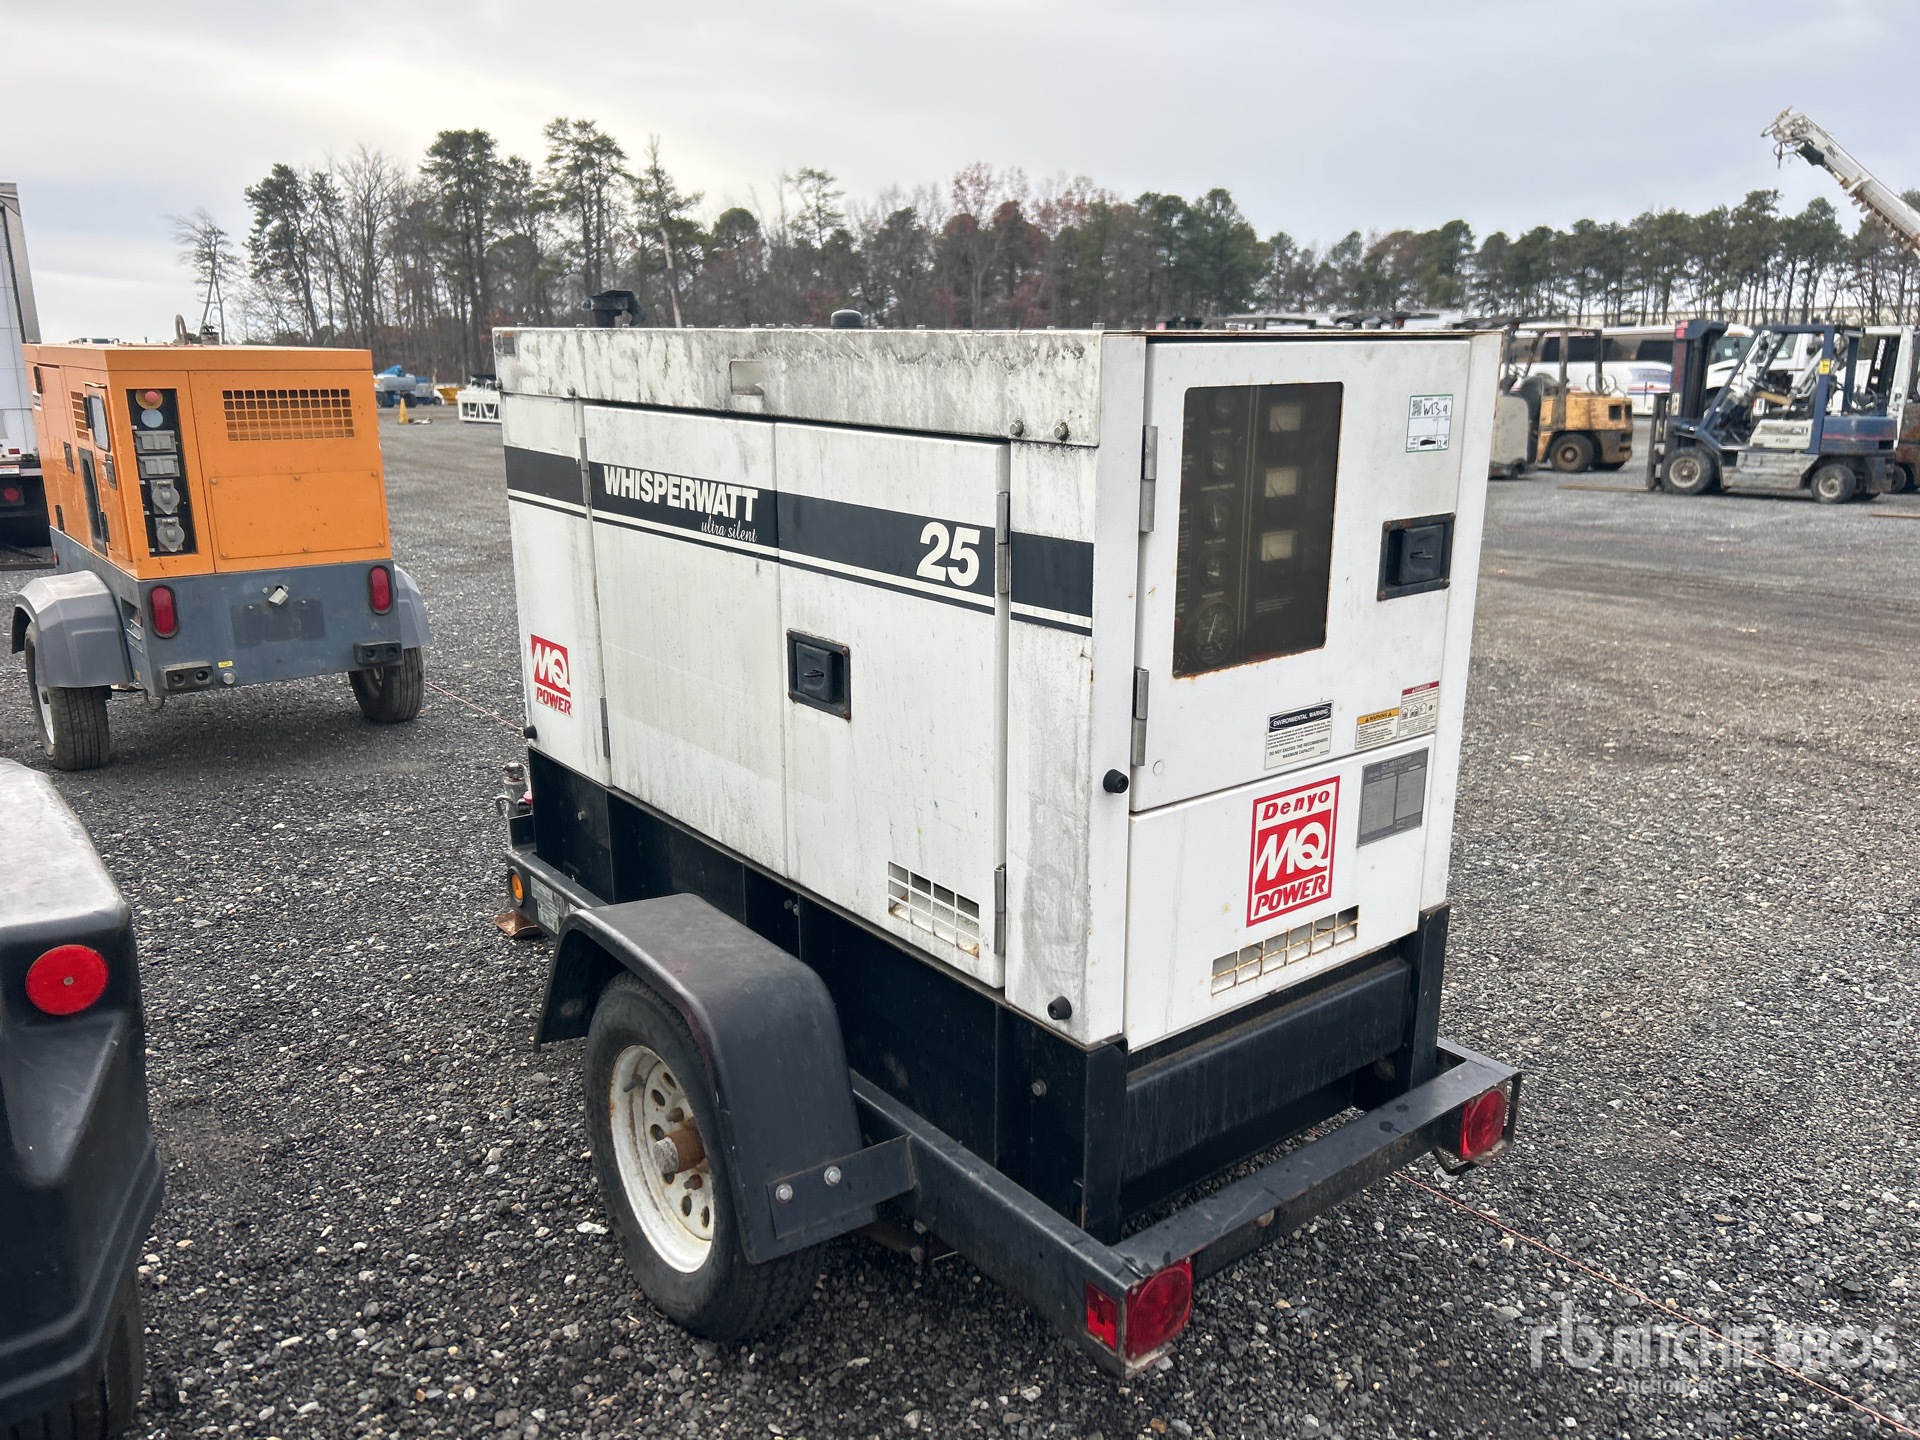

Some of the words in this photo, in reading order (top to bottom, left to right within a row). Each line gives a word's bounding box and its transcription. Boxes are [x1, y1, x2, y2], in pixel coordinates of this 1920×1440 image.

[603, 464, 759, 522] WHISPERWATT
[701, 514, 726, 537] ultra
[727, 523, 758, 543] silent
[916, 521, 981, 587] 25
[533, 642, 571, 692] MQ
[536, 686, 572, 716] POWER
[1308, 708, 1329, 718] WARNING
[1261, 789, 1331, 822] Denyo
[1255, 820, 1328, 881] MQ
[1253, 873, 1328, 917] POWER
